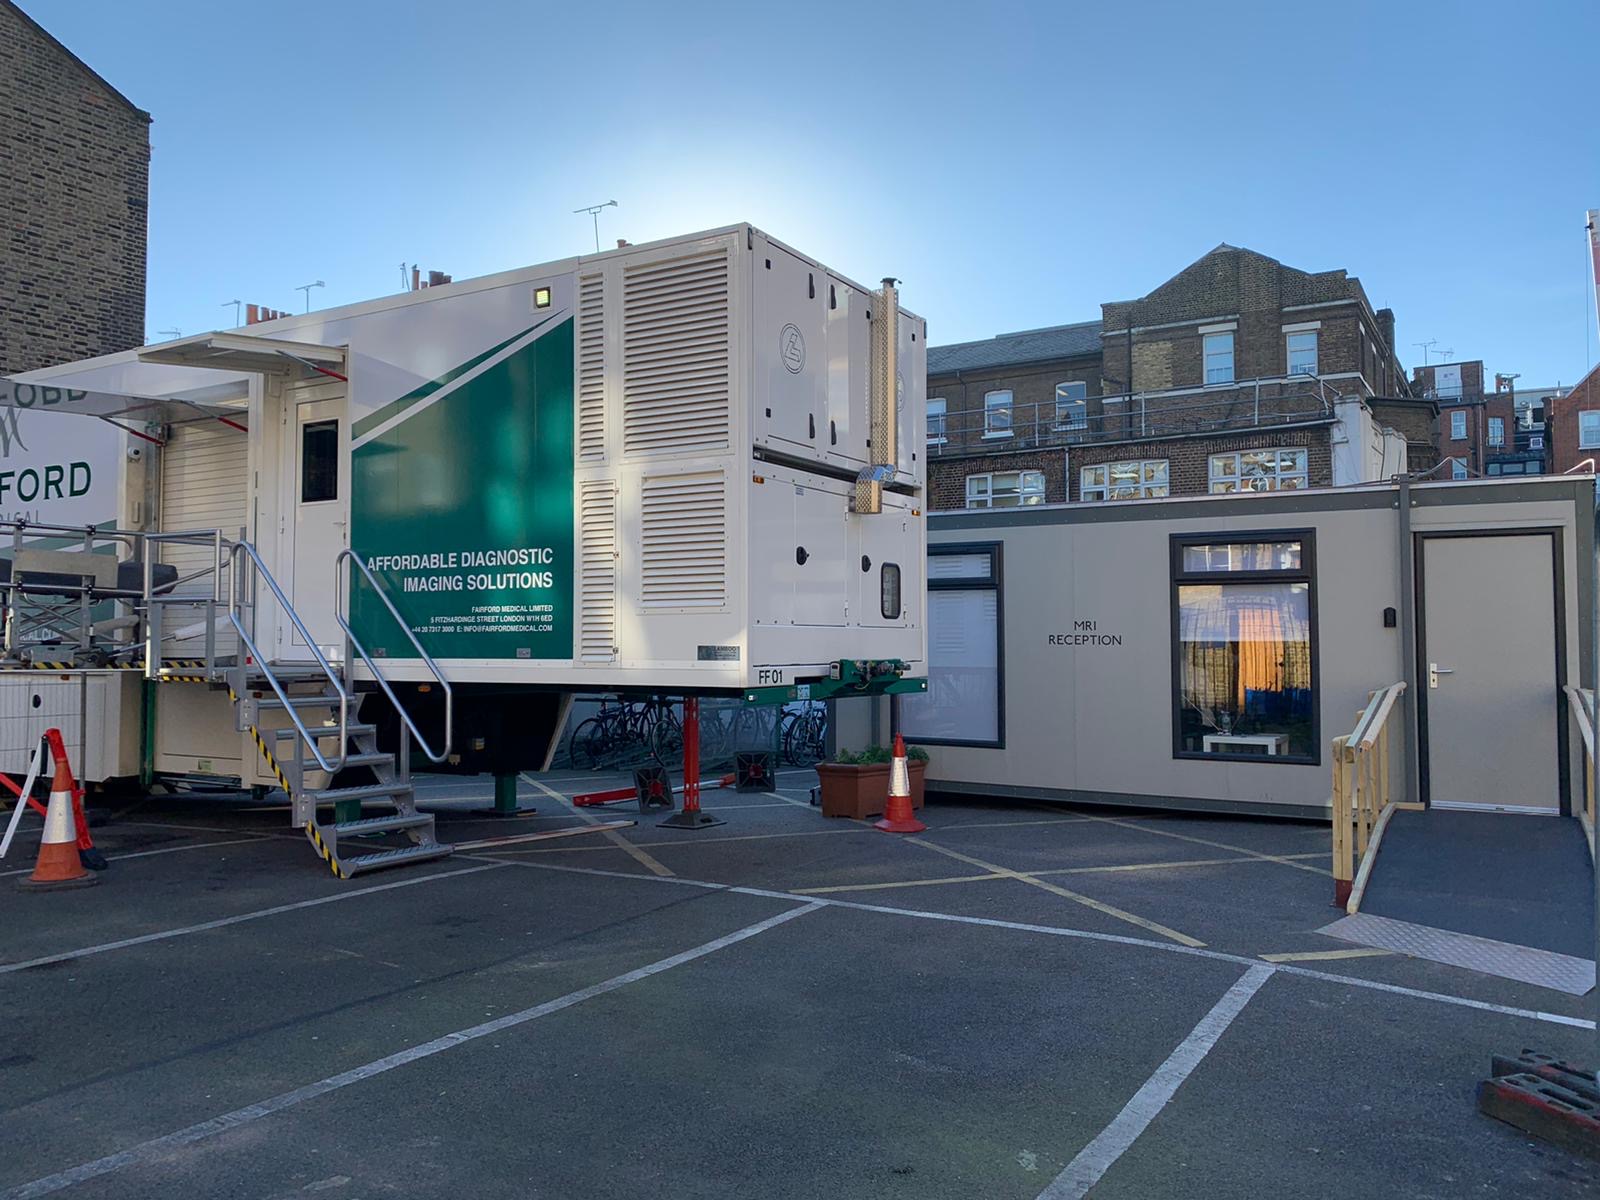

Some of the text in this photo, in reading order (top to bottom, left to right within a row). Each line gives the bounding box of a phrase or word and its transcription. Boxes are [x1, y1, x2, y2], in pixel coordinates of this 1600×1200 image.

[367, 548, 553, 571] AFFORDABLE DIAGNOSTIC
[404, 572, 553, 592] IMAGING SOLUTIONS
[1074, 621, 1096, 631] MRI
[1048, 634, 1122, 645] RECEPTION
